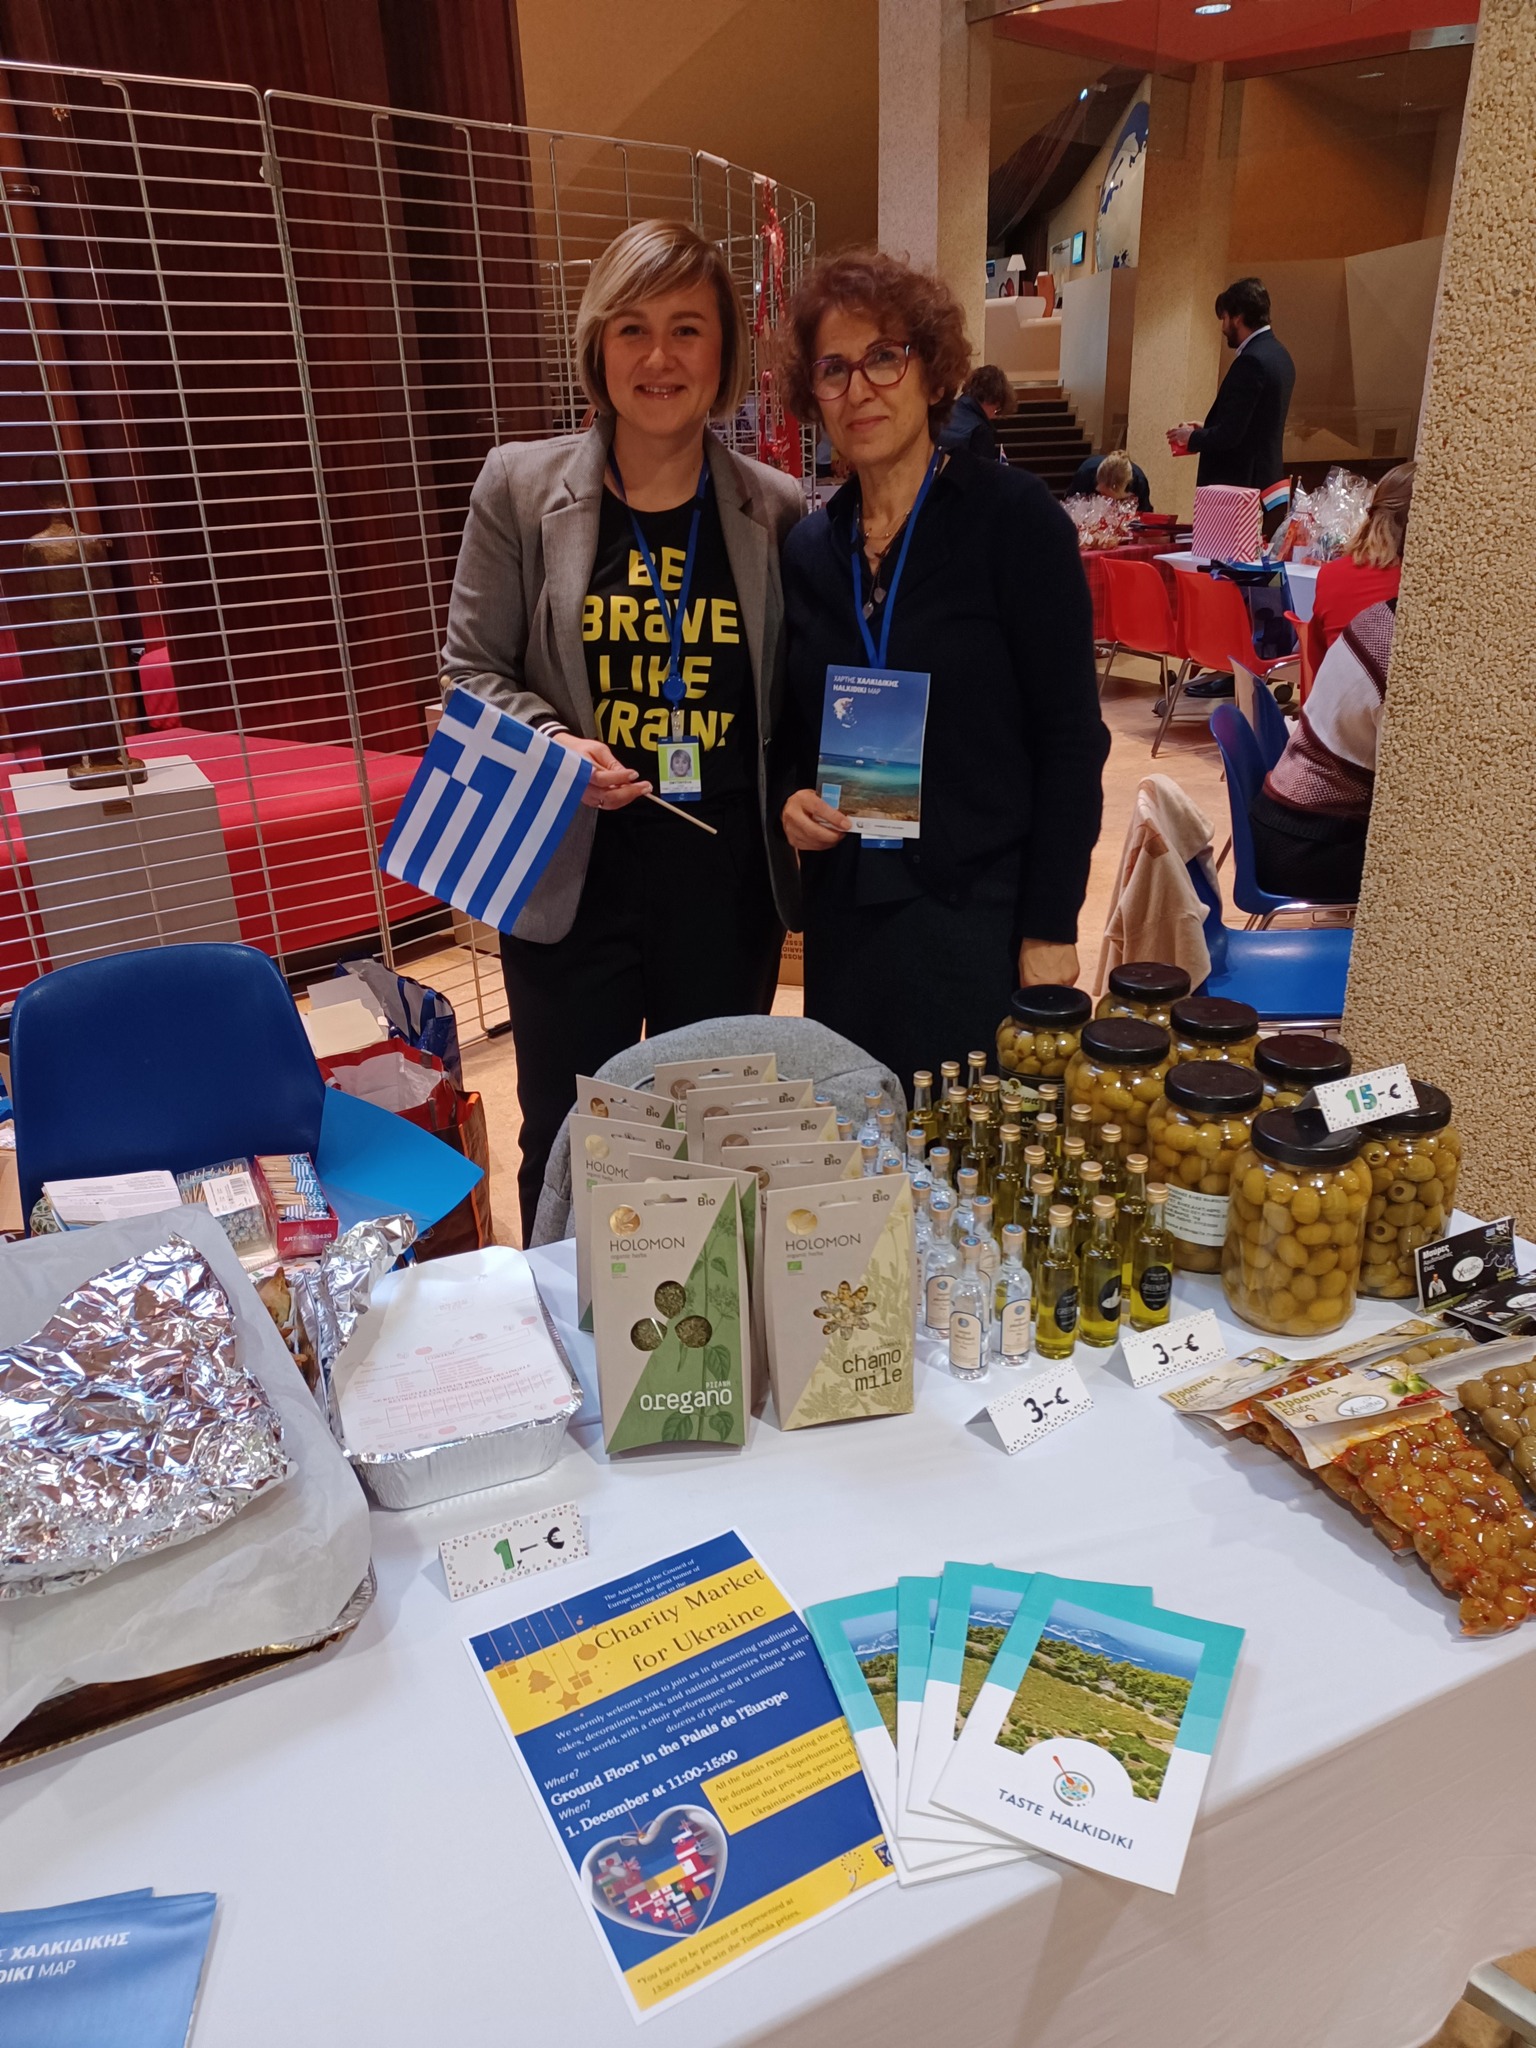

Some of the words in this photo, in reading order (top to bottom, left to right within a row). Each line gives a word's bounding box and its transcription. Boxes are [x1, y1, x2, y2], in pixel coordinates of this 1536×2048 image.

[628, 546, 686, 591] BE
[599, 654, 712, 699] LIKE
[833, 684, 867, 694] HALKIDIKI
[744, 1066, 759, 1077] Bio
[779, 1092, 795, 1103] Bio
[646, 1106, 660, 1118] Bio
[801, 1120, 817, 1131] Bio
[655, 1139, 671, 1151] Bio
[824, 1154, 842, 1166] Bio
[698, 1194, 717, 1207] Bio
[872, 1190, 890, 1203] Bio
[609, 1236, 685, 1252] HOLOMON
[785, 1233, 862, 1251] HOLOMON
[842, 1349, 901, 1374] chamo
[855, 1367, 902, 1392] mile
[640, 1388, 733, 1414] oregano
[1273, 1386, 1338, 1409] Πράσινες
[1282, 1404, 1315, 1417] Ελιές
[604, 1591, 618, 1602] The
[618, 1580, 643, 1597] Amicale
[644, 1577, 652, 1585] of
[651, 1572, 662, 1582] the
[662, 1562, 687, 1578] Council
[688, 1559, 695, 1567] of
[607, 1597, 632, 1610] Europe
[632, 1589, 645, 1600] has
[645, 1584, 656, 1594] the
[656, 1578, 673, 1591] great
[672, 1570, 692, 1584] honor
[693, 1565, 700, 1574] of
[656, 1590, 668, 1601] you
[668, 1586, 676, 1595] to
[675, 1581, 687, 1591] the
[594, 1605, 680, 1650] Charity
[684, 1568, 765, 1610] Market
[632, 1648, 668, 1673] for
[672, 1604, 767, 1652] Ukraine
[555, 1730, 572, 1740] We
[573, 1715, 605, 1733] warmly
[606, 1696, 643, 1717] welcome
[644, 1690, 660, 1704] you
[661, 1683, 670, 1693] to
[670, 1675, 688, 1690] join
[689, 1670, 700, 1680] us
[700, 1664, 711, 1674] in
[711, 1643, 758, 1670] discovering
[757, 1624, 799, 1648] traditional
[556, 1739, 585, 1755] cakes,
[585, 1714, 638, 1742] decorations,
[638, 1701, 667, 1716] books,
[667, 1691, 684, 1705] and
[684, 1675, 720, 1695] national
[719, 1657, 760, 1680] souvenirs
[759, 1647, 780, 1661] from
[780, 1641, 792, 1652] all
[792, 1633, 810, 1647] over
[576, 1748, 591, 1760] the
[592, 1736, 620, 1753] world,
[620, 1725, 640, 1741] with
[641, 1723, 648, 1731] a
[648, 1711, 671, 1727] choir
[672, 1686, 726, 1718] performance
[726, 1677, 744, 1691] and
[744, 1675, 751, 1683] a
[787, 1649, 807, 1662] with
[665, 1715, 697, 1734] dozens
[697, 1709, 707, 1720] of
[708, 1698, 736, 1716] prizes.
[550, 1776, 603, 1807] Ground
[603, 1758, 641, 1783] Floor
[641, 1751, 658, 1766] in
[658, 1740, 681, 1758] the
[680, 1722, 720, 1747] Palais
[720, 1713, 738, 1729] de
[736, 1690, 790, 1721] l'Europe
[715, 1781, 727, 1791] All
[727, 1773, 741, 1786] the
[741, 1763, 765, 1779] funds
[765, 1751, 790, 1768] raised
[790, 1738, 817, 1755] during
[817, 1731, 829, 1743] the
[830, 1725, 849, 1737] even
[543, 1768, 580, 1790] Where?
[718, 1792, 730, 1804] be
[730, 1778, 763, 1799] donated
[763, 1774, 773, 1785] to
[773, 1767, 786, 1780] the
[786, 1742, 840, 1771] Superhumans
[728, 1793, 761, 1814] Ukraine
[761, 1785, 778, 1798] that
[779, 1769, 812, 1792] provides
[812, 1748, 854, 1776] specialized
[564, 1820, 581, 1839] 1.
[580, 1792, 651, 1831] December
[651, 1784, 668, 1799] at
[669, 1749, 740, 1791] 11:00-15:00
[751, 1792, 797, 1817] Ukrainians
[797, 1775, 833, 1796] wounded
[832, 1769, 842, 1781] by
[842, 1762, 856, 1774] the
[558, 1799, 592, 1821] When?
[998, 1788, 1045, 1817] TASTE
[1049, 1810, 1134, 1850] HALKIDIKI
[10, 1931, 131, 1960] ΧΑΛΚΙΔΙΚΗΣ
[0, 1965, 35, 1984] DIKI
[38, 1959, 77, 1977] MAP
